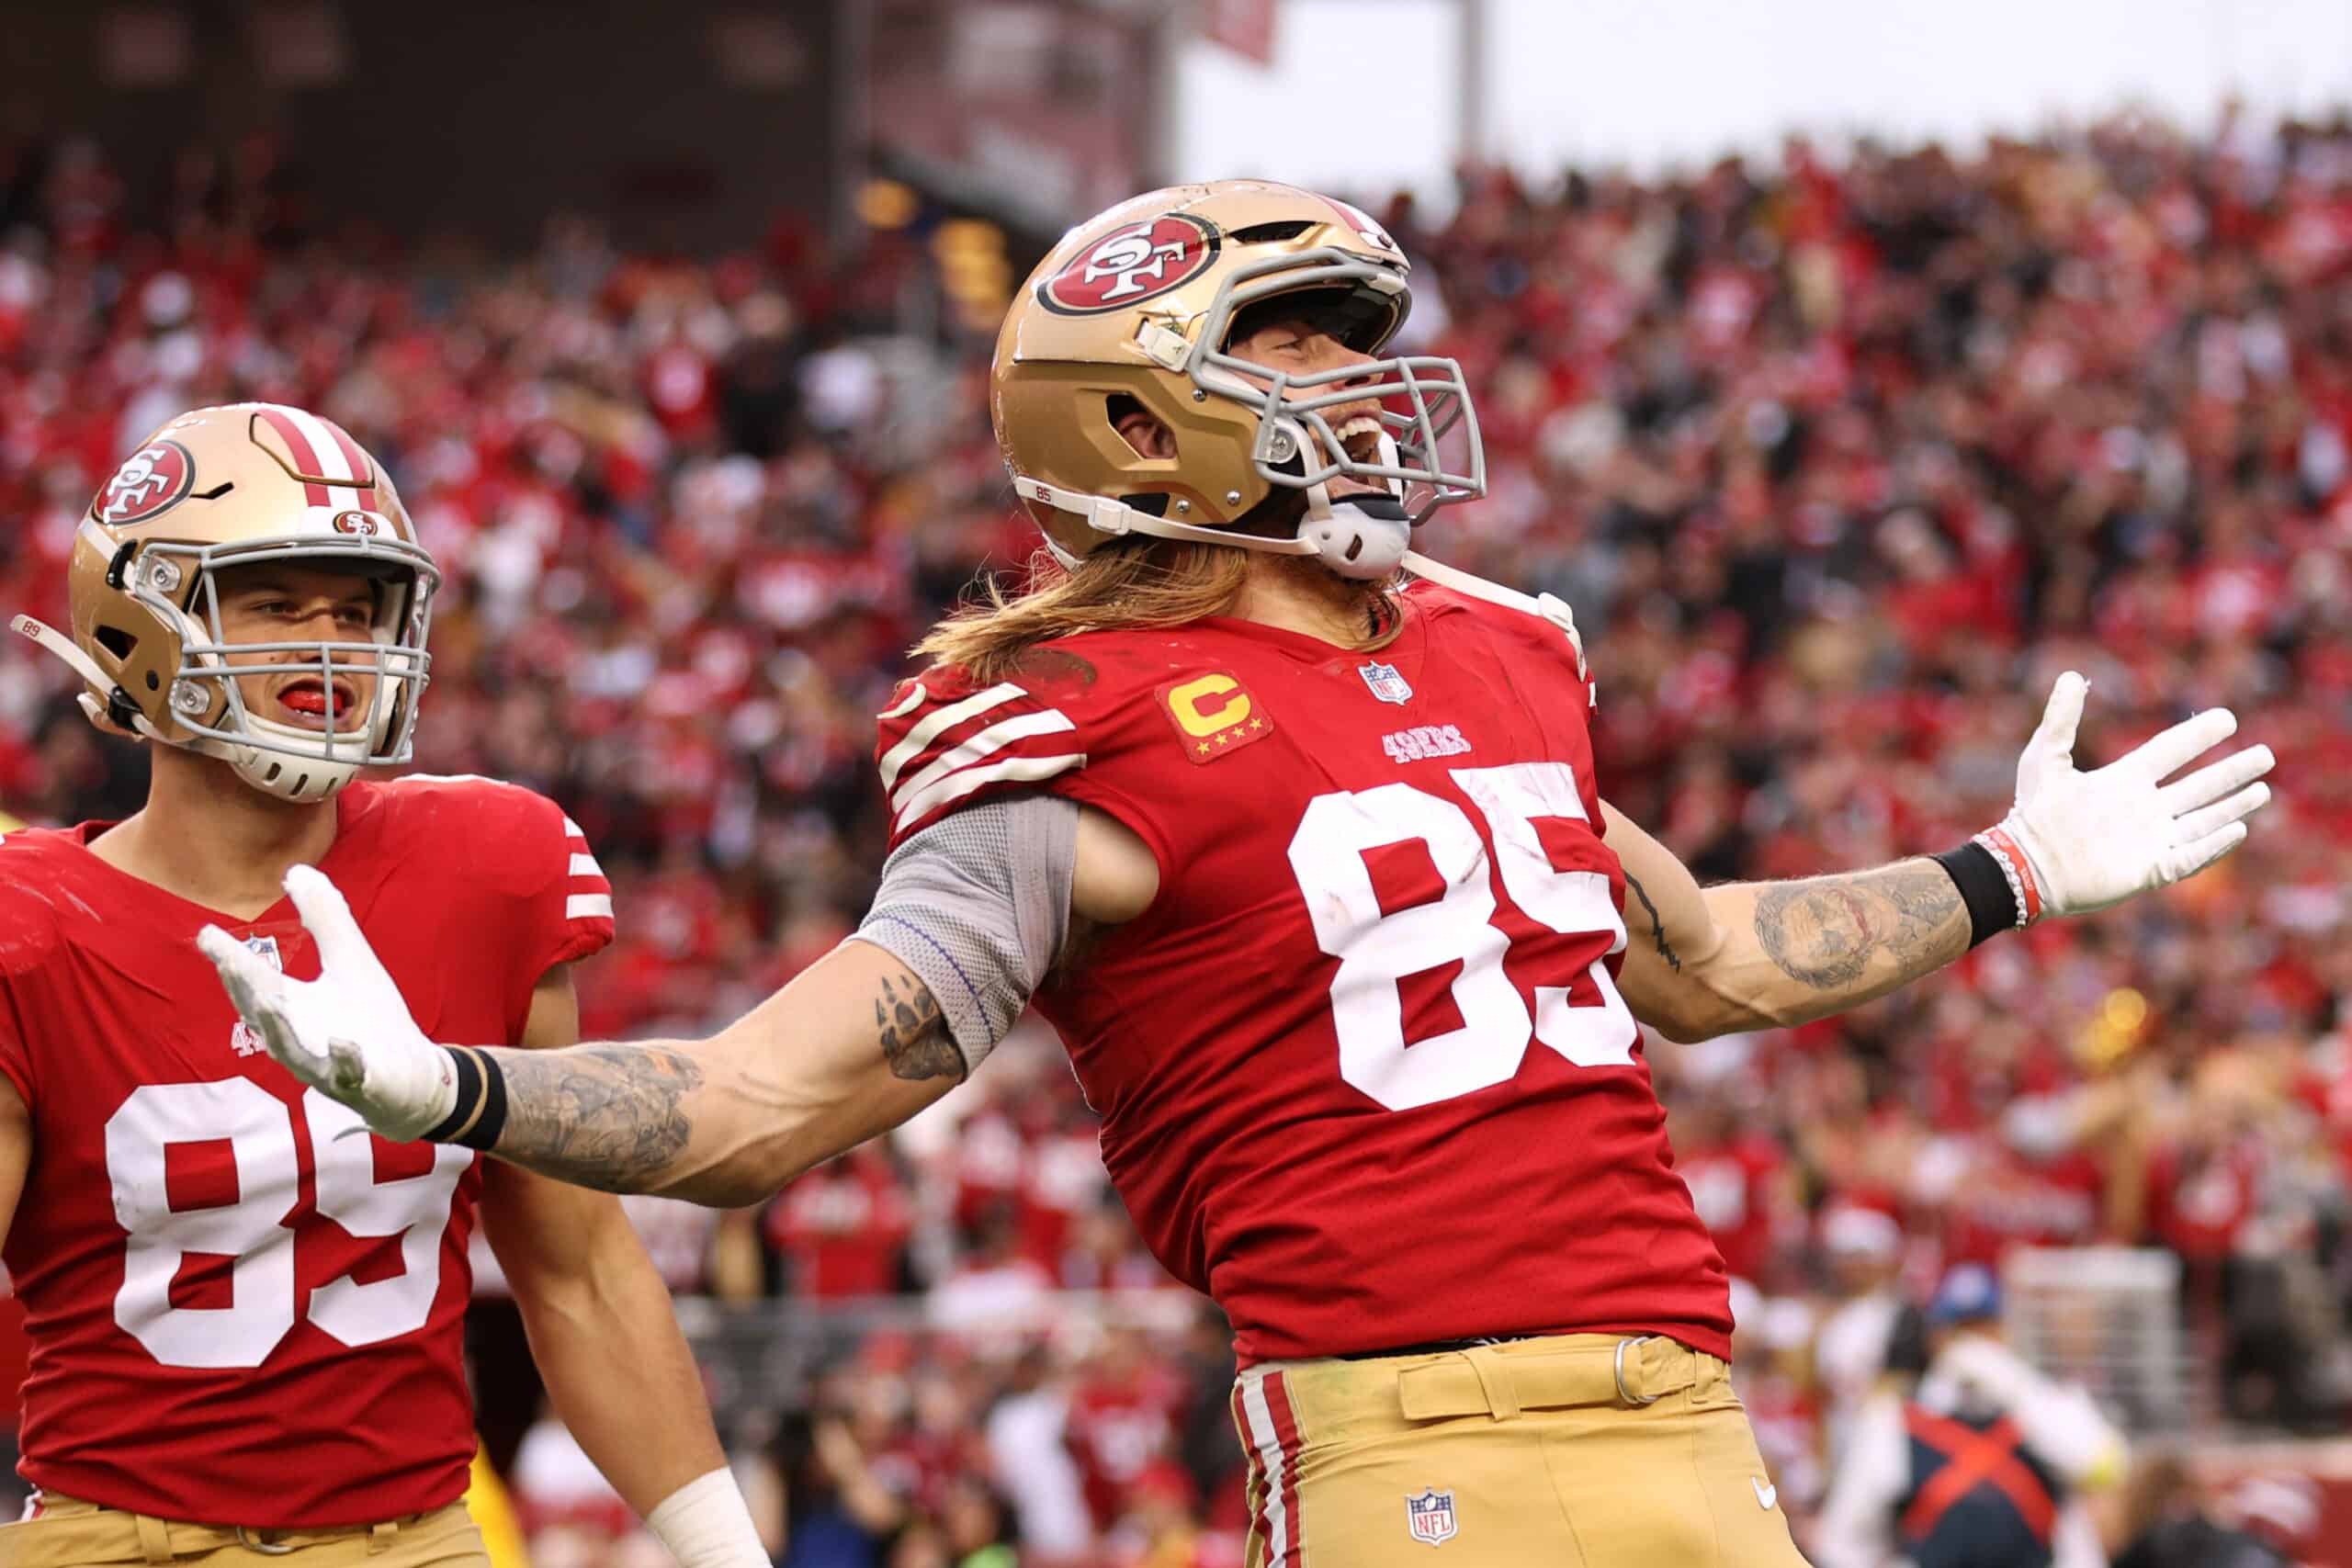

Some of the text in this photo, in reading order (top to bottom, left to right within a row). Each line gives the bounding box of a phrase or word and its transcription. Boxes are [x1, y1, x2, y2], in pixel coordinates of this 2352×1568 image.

[1084, 222, 1185, 301] SF
[107, 448, 169, 513] SF
[1035, 486, 1052, 502] 85
[22, 620, 41, 637] 89
[1168, 673, 1251, 737] C
[1382, 724, 1472, 763] 49ERS
[1286, 761, 1639, 1112] 85
[104, 1076, 476, 1369] 89
[1417, 1513, 1451, 1536] NFL
